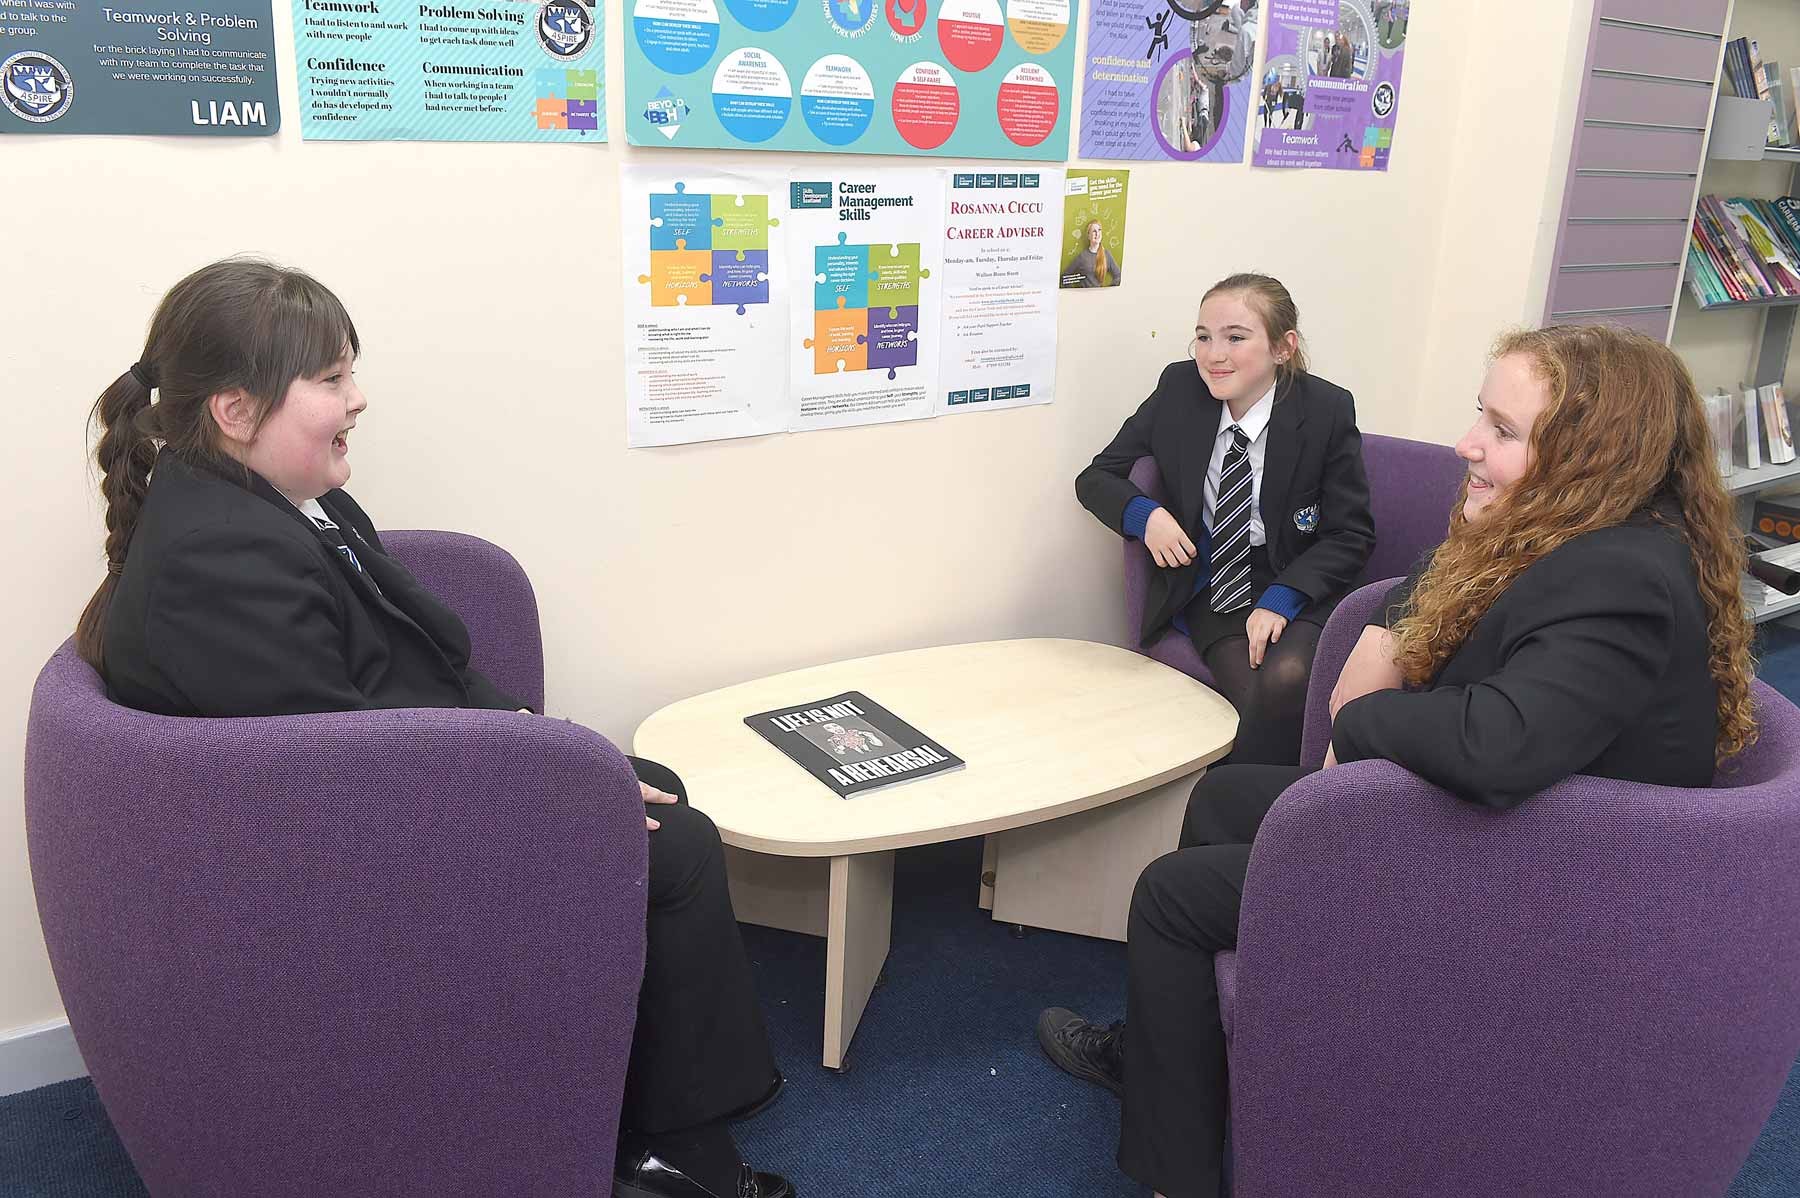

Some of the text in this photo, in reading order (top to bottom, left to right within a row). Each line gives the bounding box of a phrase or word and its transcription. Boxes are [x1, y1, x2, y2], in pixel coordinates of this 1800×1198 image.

[34, 1, 55, 9] was
[56, 1, 76, 10] with
[303, 0, 380, 14] Teamwork
[21, 13, 38, 22] talk
[103, 8, 258, 29] Teamwork & Problem
[419, 5, 525, 25] Problem Solving
[308, 18, 325, 26] had
[336, 18, 360, 28] listen
[360, 20, 370, 28] to
[370, 21, 386, 29] and
[386, 22, 408, 30] work
[423, 24, 438, 32] had
[470, 28, 480, 36] up
[482, 26, 498, 35] with
[498, 28, 519, 36] ideas
[8, 27, 39, 36] group.
[157, 28, 211, 45] Solving
[306, 30, 326, 38] with
[345, 32, 372, 42] people
[552, 32, 578, 42] ASPIRE
[429, 38, 441, 46] get
[442, 36, 460, 45] each
[462, 38, 478, 46] task
[478, 38, 497, 46] done
[498, 39, 514, 48] well
[94, 44, 105, 52] for
[108, 45, 122, 54] the
[125, 46, 146, 54] brick
[148, 46, 175, 58] laying
[182, 48, 199, 56] had
[200, 48, 210, 57] to
[212, 50, 267, 60] communicate
[100, 58, 264, 72] with my team to complete the task that
[307, 58, 386, 72] Confidence
[1092, 56, 1152, 68] confidence and
[422, 62, 524, 76] Communication
[128, 72, 150, 80] were
[152, 73, 186, 82] working
[202, 74, 255, 85] successfully.
[310, 76, 338, 86] Trying
[358, 78, 395, 86] activities
[1092, 70, 1149, 84] determination
[424, 80, 447, 88] When
[448, 80, 480, 90] working
[1308, 79, 1368, 92] communication
[20, 90, 54, 104] ASPIRE
[316, 88, 351, 97] wouldn't
[353, 90, 389, 99] normally
[428, 92, 444, 100] had
[454, 92, 469, 100] talk
[478, 93, 503, 102] people
[312, 100, 322, 108] do
[324, 101, 338, 109] has
[339, 101, 380, 111] developed
[426, 103, 440, 111] had
[191, 100, 267, 126] LIAM
[312, 113, 358, 121] confidence
[1282, 132, 1319, 144] Teamwork
[839, 182, 876, 194] Career
[839, 196, 913, 209] Management
[951, 200, 1044, 214] ROSANNA CICCU
[839, 208, 870, 220] Skills
[947, 226, 1044, 240] CAREER ADVISER
[722, 280, 758, 288] NETWORKS
[834, 284, 850, 293] SELF
[769, 700, 865, 732] LIFE IS NOT
[827, 744, 949, 787] A REHEARSAL
